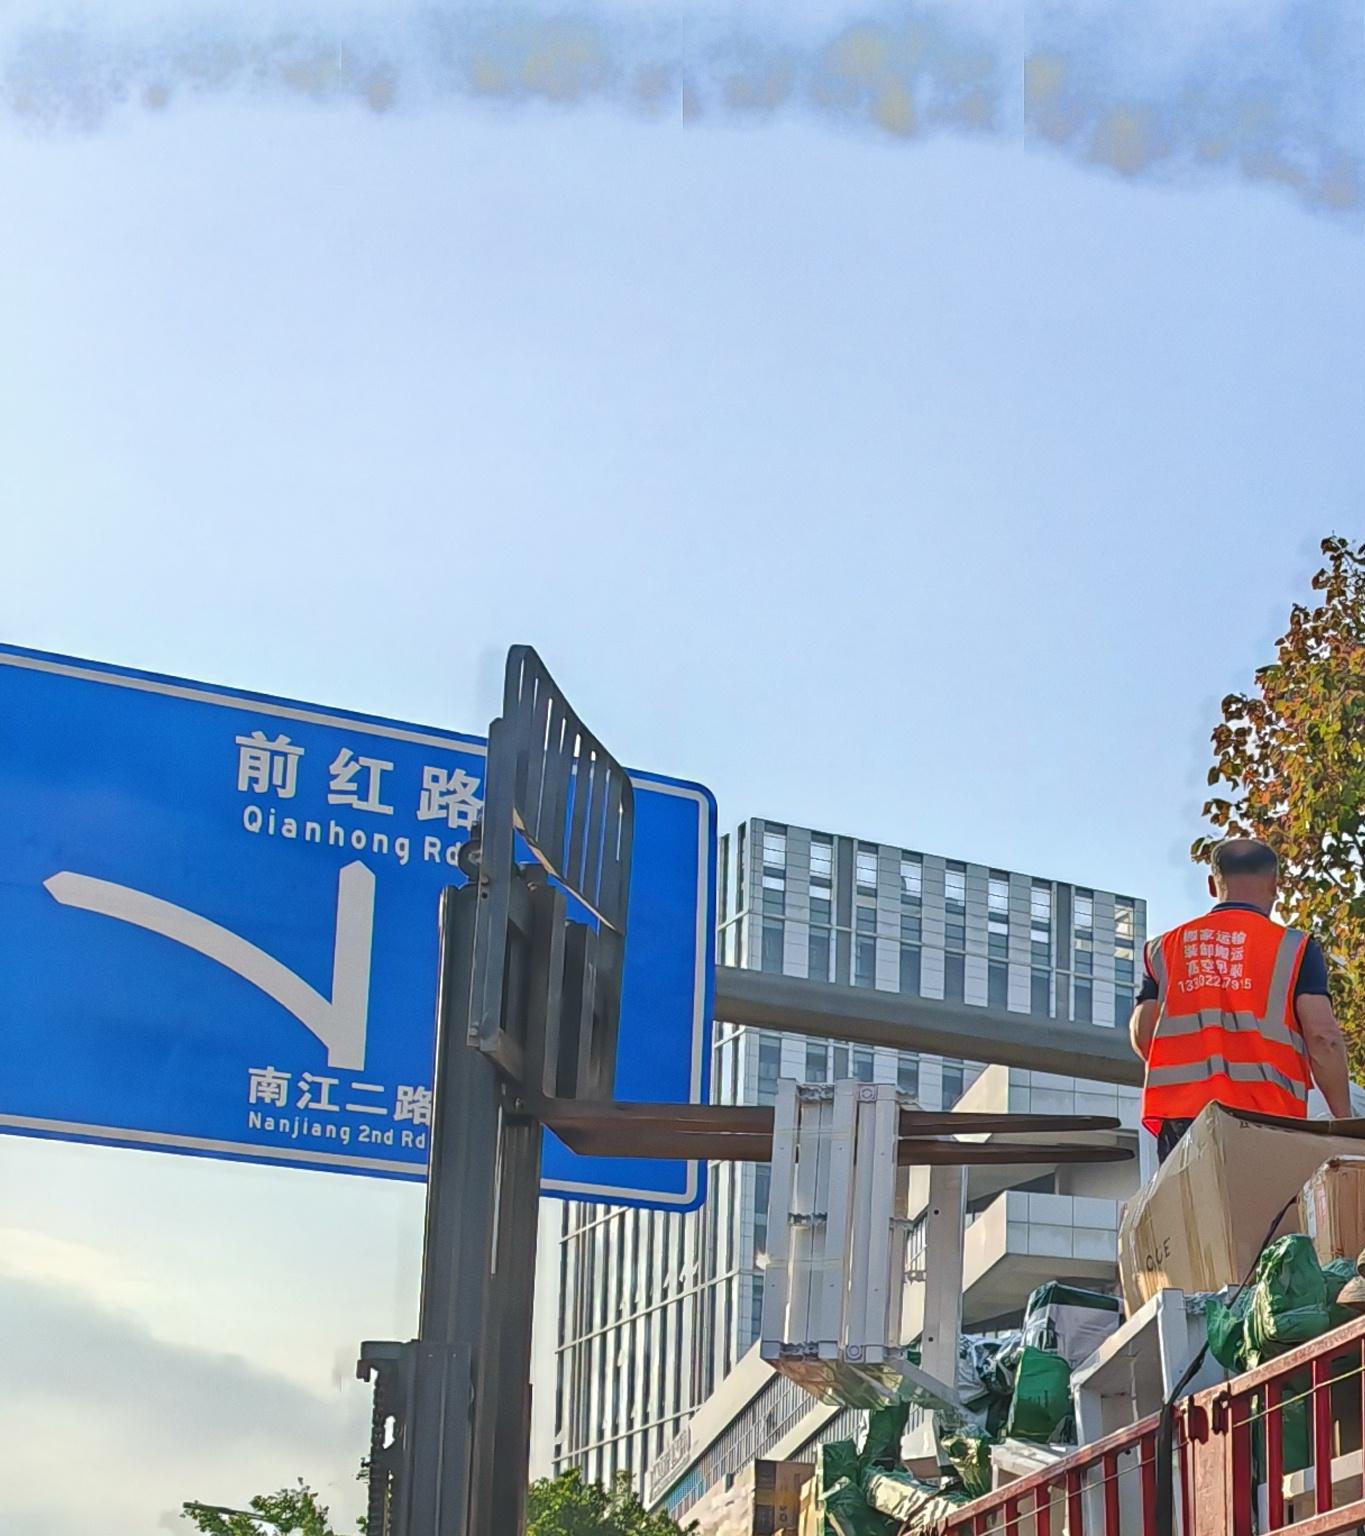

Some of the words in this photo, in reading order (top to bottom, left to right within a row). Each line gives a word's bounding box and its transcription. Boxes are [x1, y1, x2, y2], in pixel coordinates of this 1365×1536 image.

[235, 731, 484, 831] 前红路
[243, 806, 410, 866] Qianhong
[424, 836, 462, 866] Rd
[248, 1066, 433, 1127] 南江二路
[248, 1112, 351, 1145] Nanjiang
[358, 1125, 394, 1146] 2nd
[402, 1131, 427, 1149] Rd
